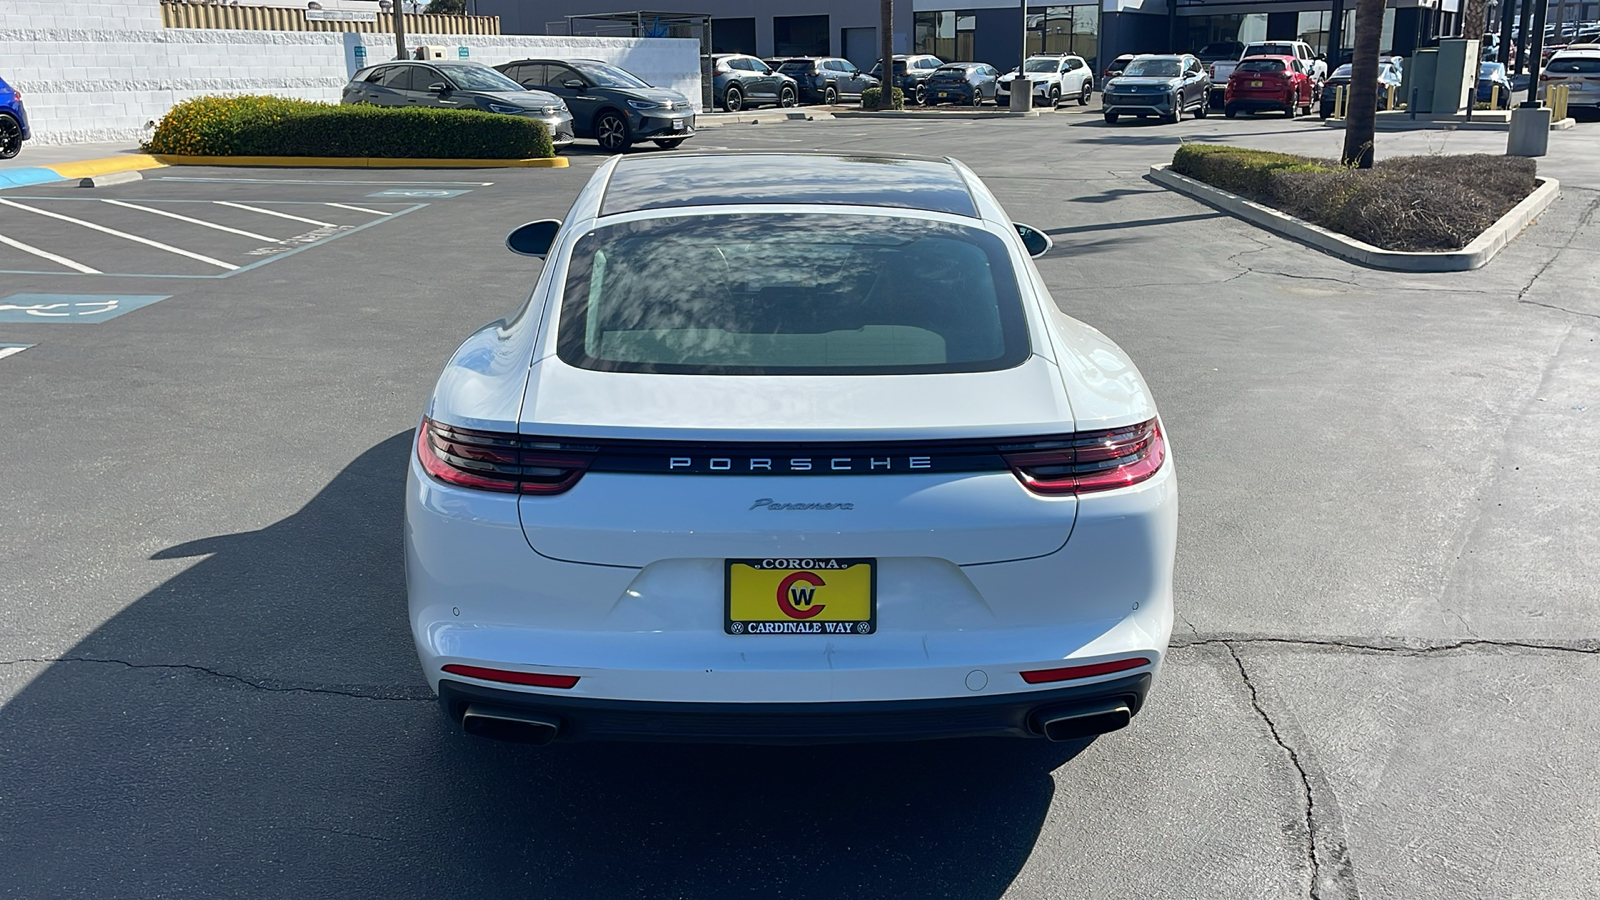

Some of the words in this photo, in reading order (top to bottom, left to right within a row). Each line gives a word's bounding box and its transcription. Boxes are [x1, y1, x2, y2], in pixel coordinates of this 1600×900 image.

[669, 456, 932, 471] PORSCHE
[749, 497, 855, 511] Panamera
[762, 558, 840, 569] CORONA
[748, 622, 822, 634] CARDINALE
[825, 622, 854, 634] WAY
